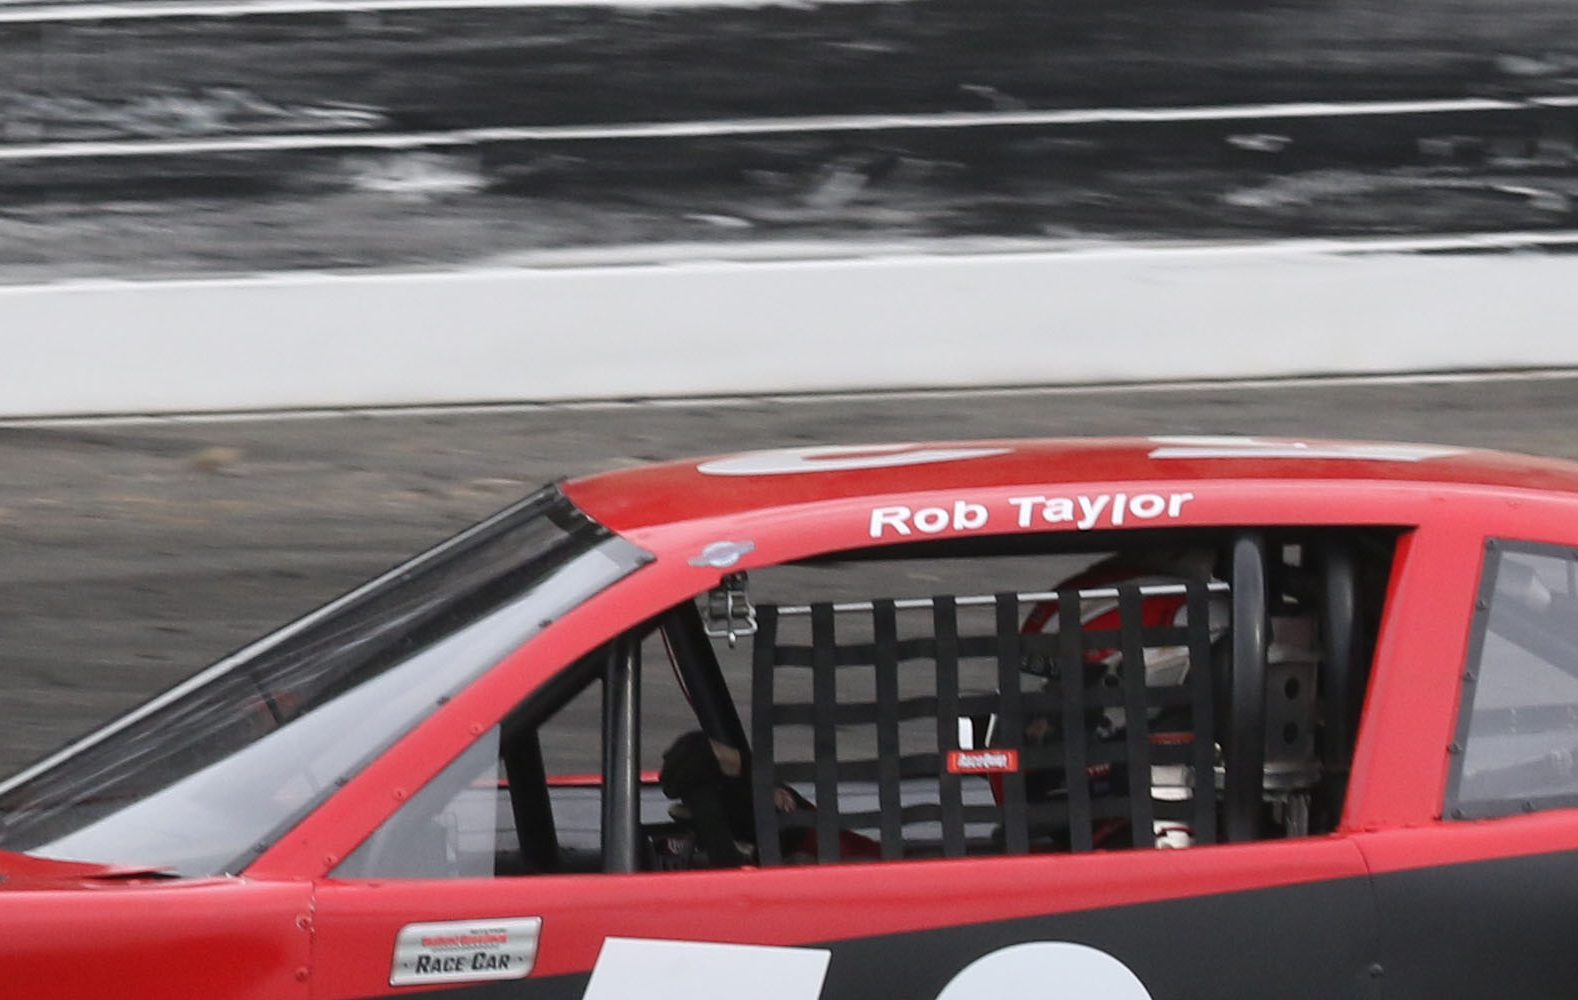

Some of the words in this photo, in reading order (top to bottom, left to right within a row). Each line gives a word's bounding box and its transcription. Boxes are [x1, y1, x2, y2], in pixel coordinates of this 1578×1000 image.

[869, 500, 989, 537] Rob
[1008, 492, 1194, 531] Taylor
[415, 954, 466, 974] RACE
[471, 951, 511, 971] CAR
